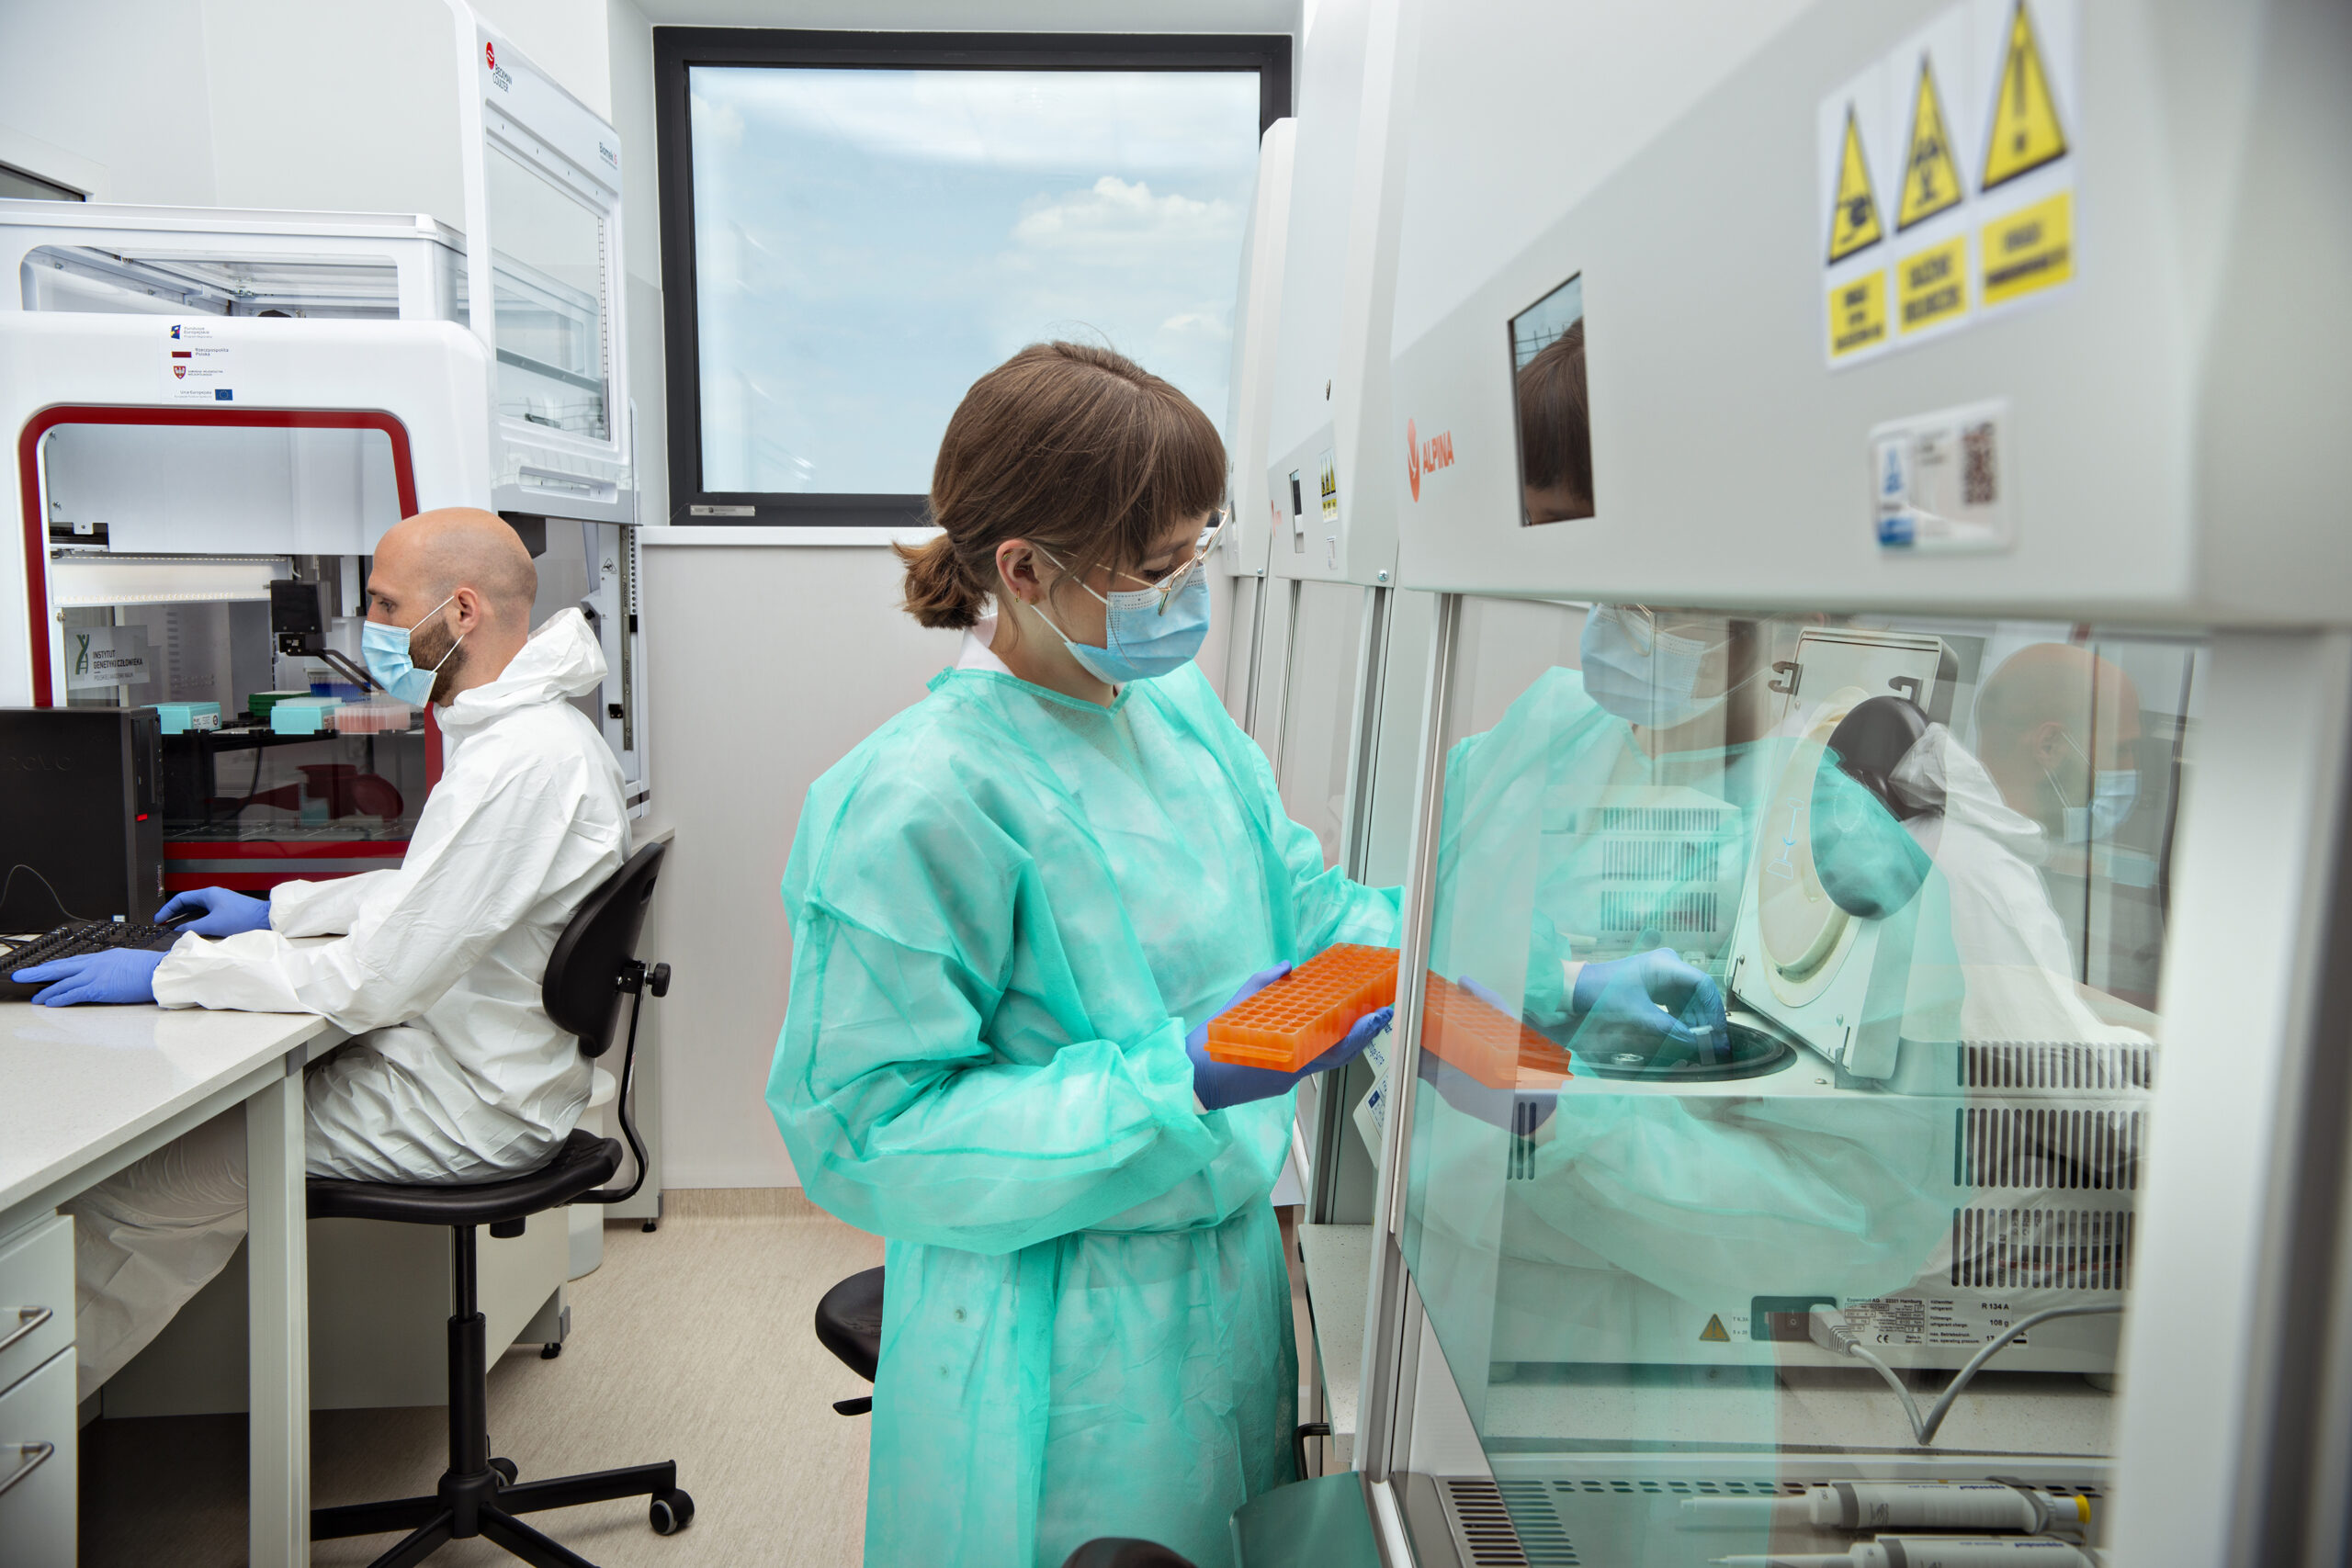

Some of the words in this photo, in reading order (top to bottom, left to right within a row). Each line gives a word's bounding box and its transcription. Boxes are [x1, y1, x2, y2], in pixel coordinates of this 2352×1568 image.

[1422, 429, 1455, 476] ALPINA
[93, 649, 116, 659] INSTYTUT
[93, 660, 117, 670] GENETYKI
